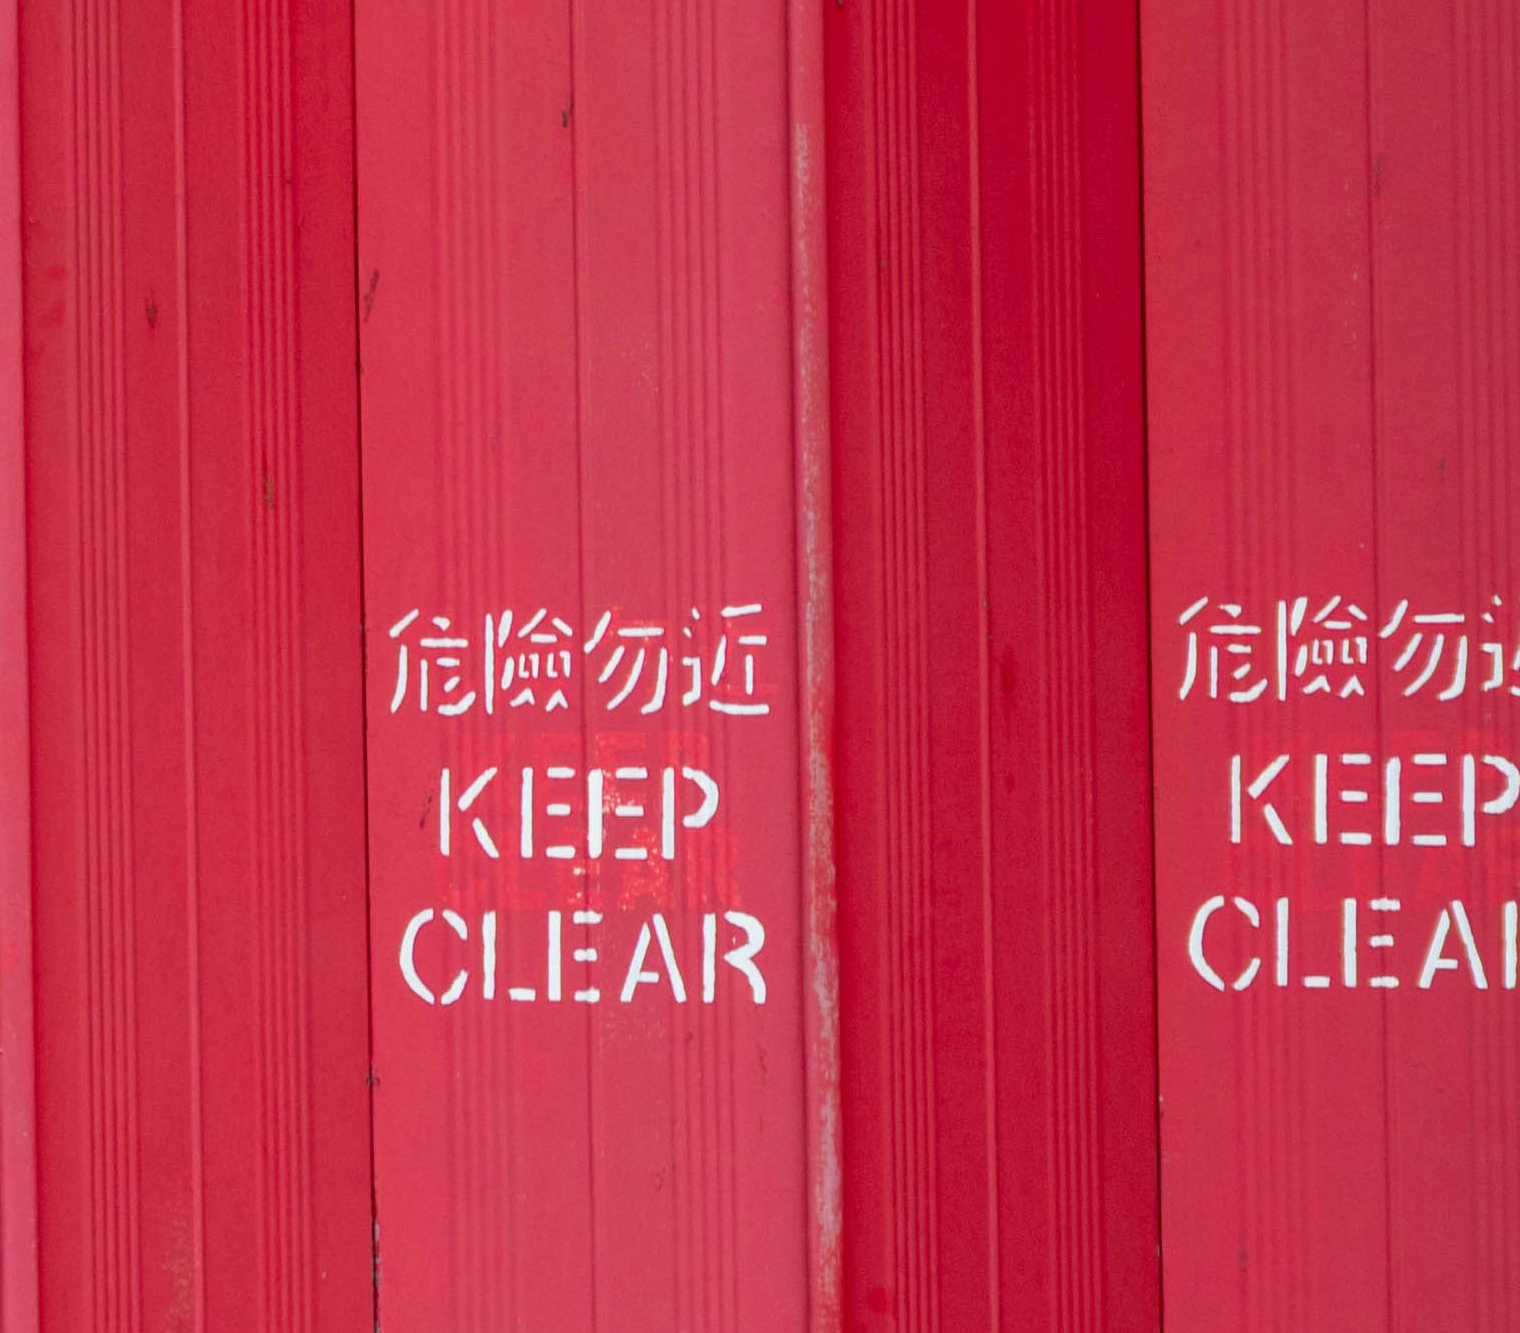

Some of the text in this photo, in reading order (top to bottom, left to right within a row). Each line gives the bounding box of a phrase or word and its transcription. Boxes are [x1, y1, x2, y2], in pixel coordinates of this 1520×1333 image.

[389, 604, 769, 716] 危險勿近
[440, 766, 719, 860] KEEP
[1231, 754, 1520, 846] KEEP
[399, 908, 766, 1005] CLEAR
